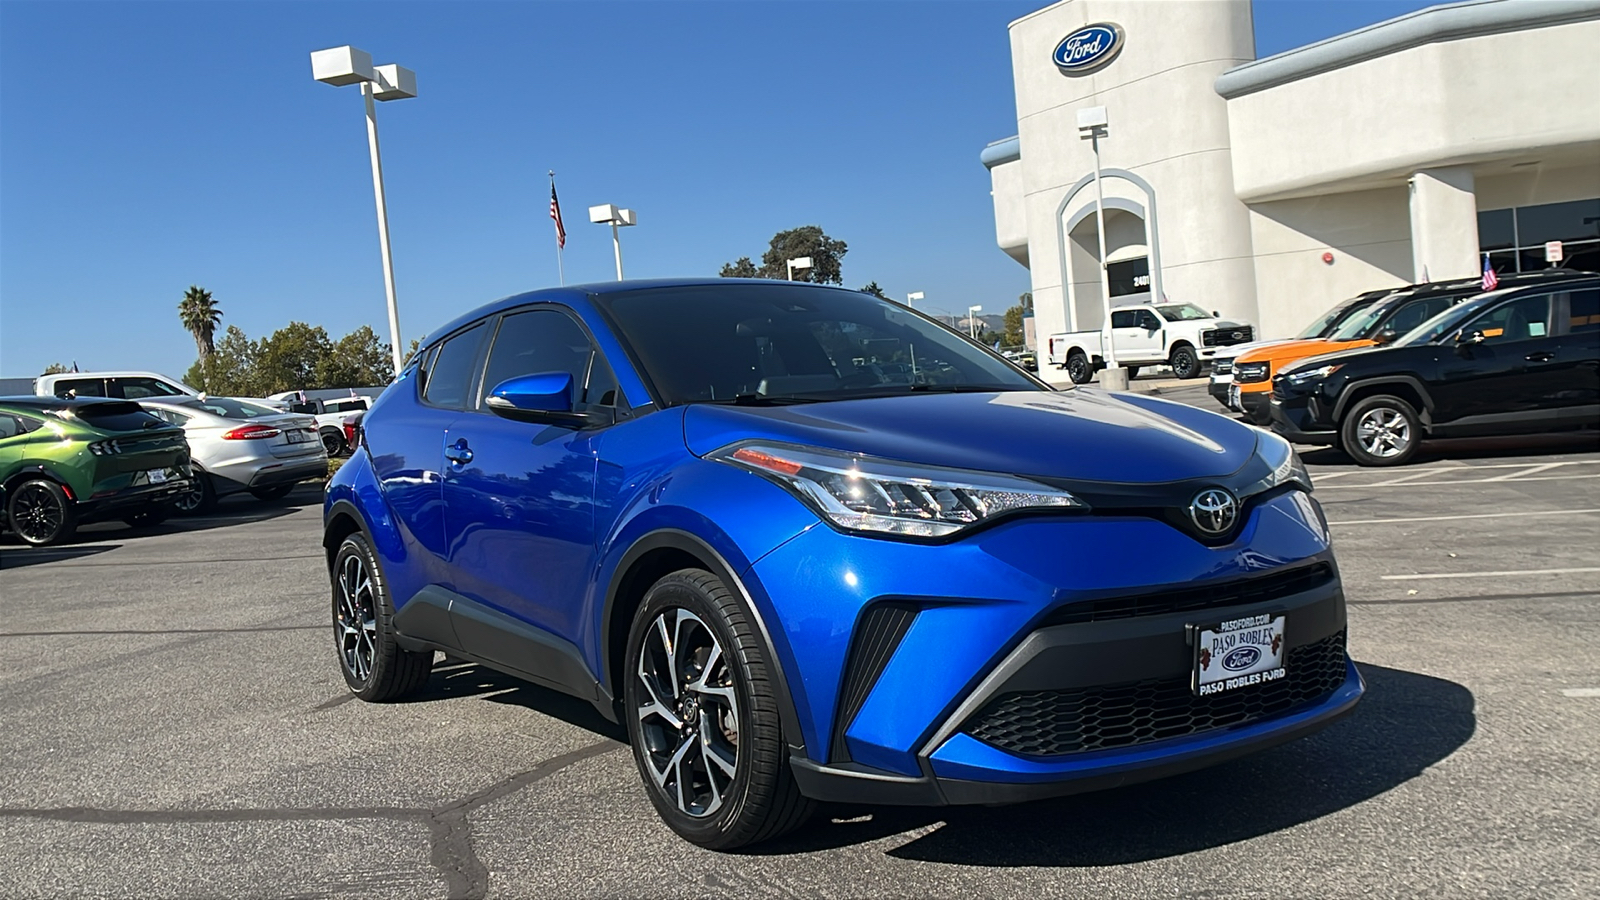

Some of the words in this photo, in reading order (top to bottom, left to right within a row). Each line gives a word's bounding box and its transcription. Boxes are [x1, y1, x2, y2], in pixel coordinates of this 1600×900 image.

[1063, 32, 1102, 62] Ford
[1221, 613, 1270, 632] PASOFORD.COM
[1212, 634, 1236, 657] PASO
[1239, 627, 1274, 646] ROBLES
[1229, 650, 1254, 667] Ford
[1200, 681, 1224, 696] PASO
[1226, 673, 1261, 690] ROBLES
[1262, 668, 1286, 682] FORD
